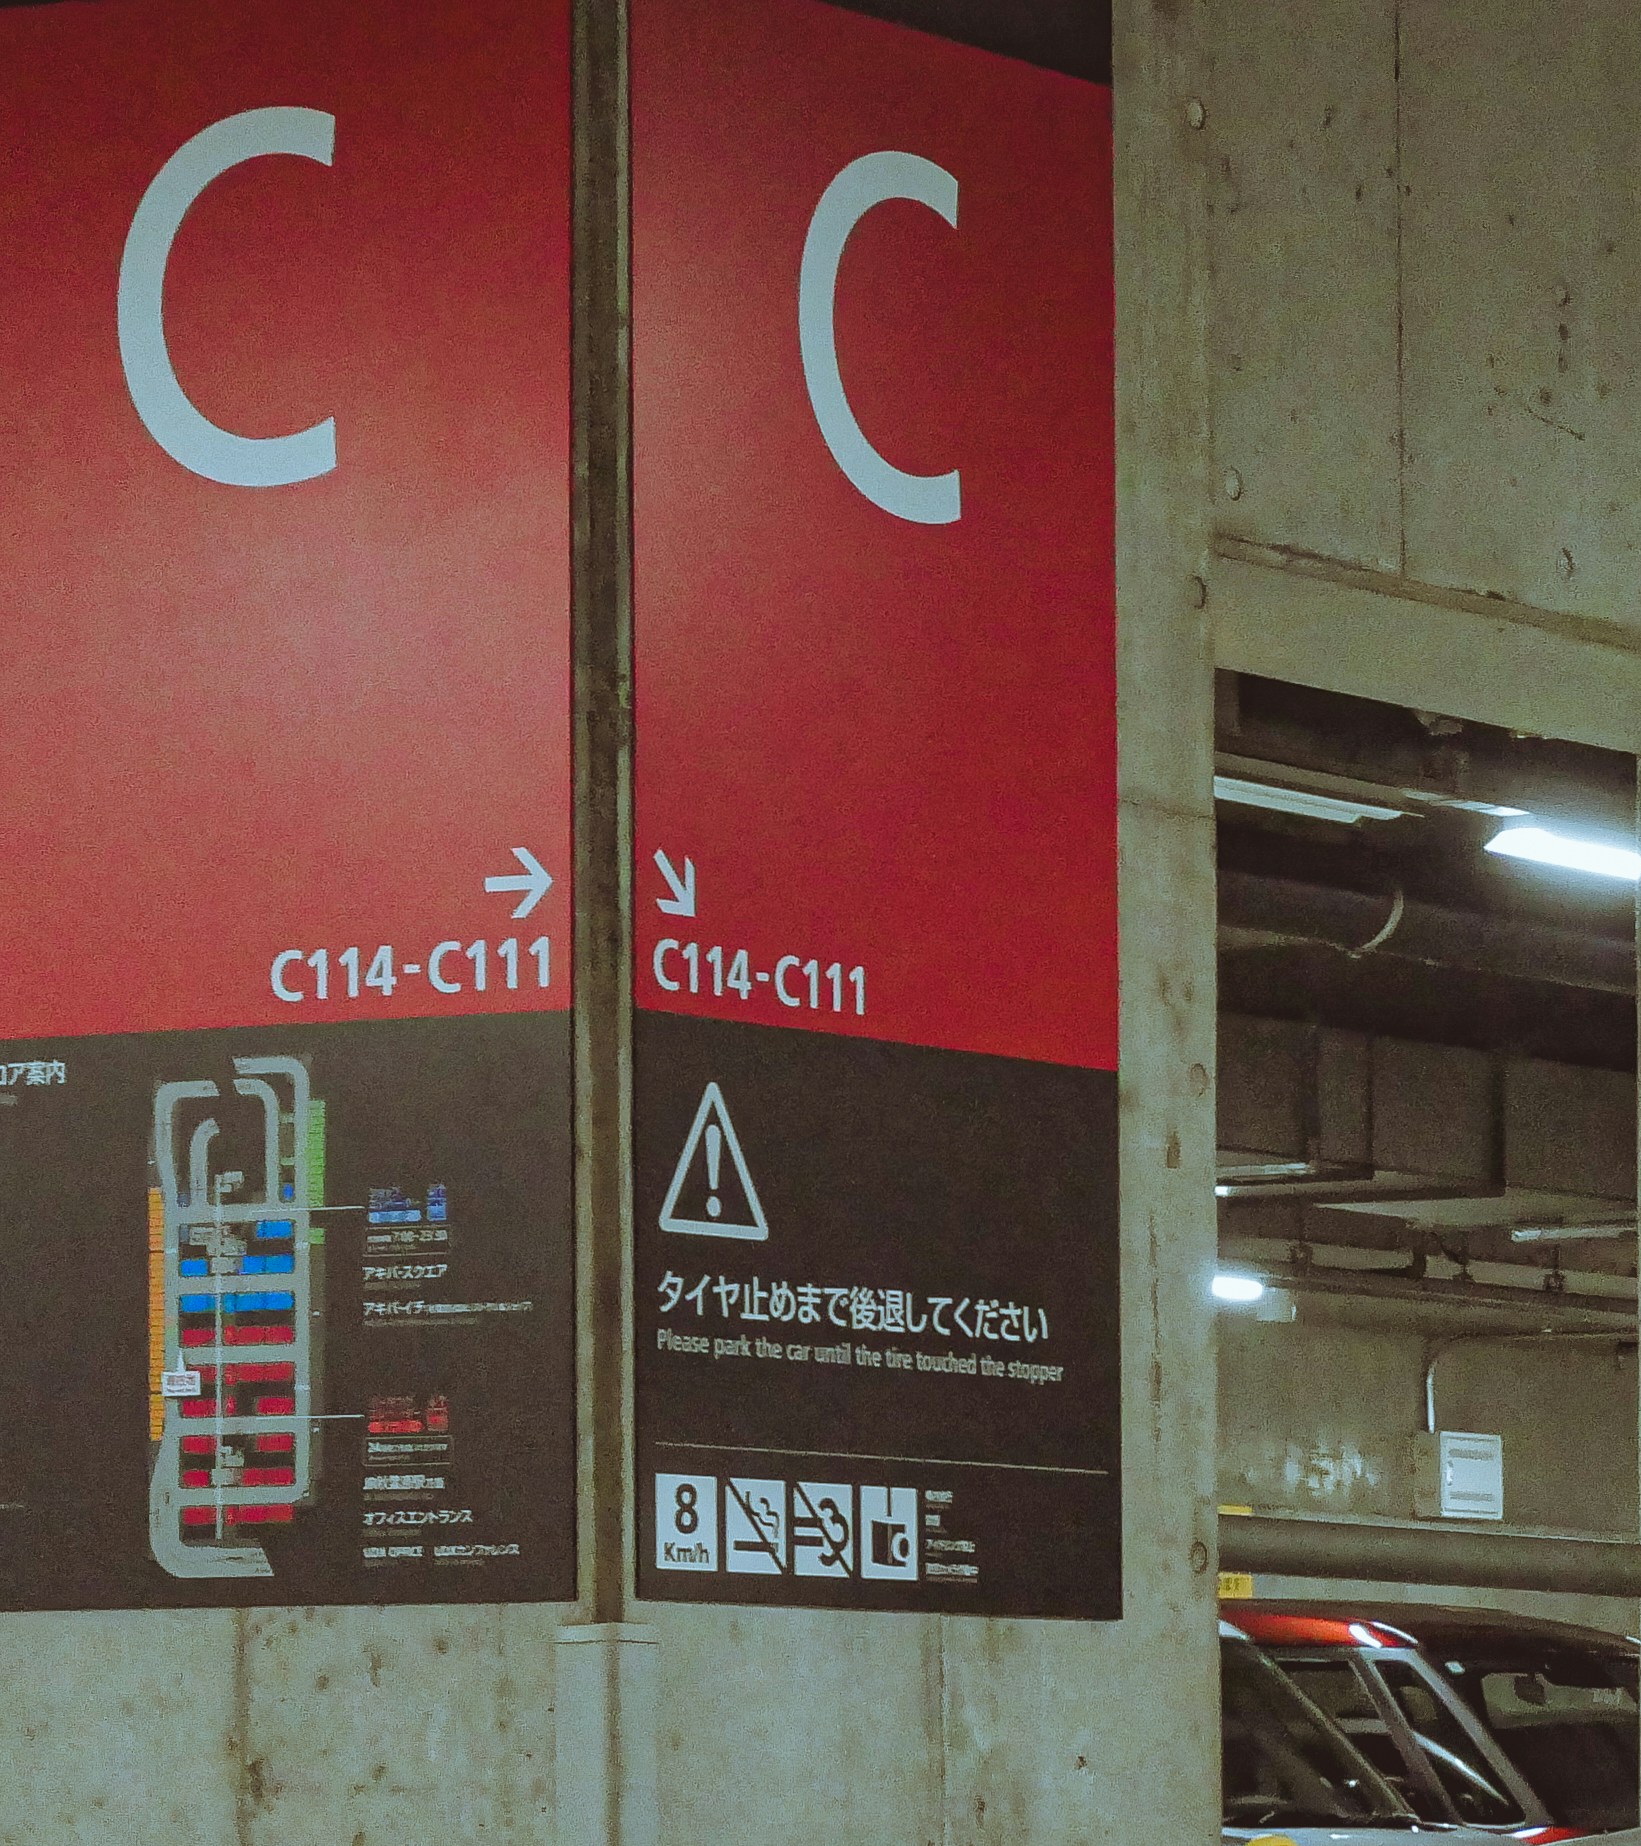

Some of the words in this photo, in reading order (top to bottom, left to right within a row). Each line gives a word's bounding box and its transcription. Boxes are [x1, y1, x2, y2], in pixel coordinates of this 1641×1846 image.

[117, 106, 337, 487] C
[799, 150, 961, 524] C
[270, 936, 550, 1002] C114-C111
[653, 938, 865, 1015] C114-C111
[657, 1270, 1049, 1343] タイヤ止めまで後退してください
[657, 1328, 710, 1354] Please
[713, 1334, 753, 1360] park
[755, 1337, 783, 1360] the
[786, 1342, 811, 1361] car
[814, 1342, 851, 1366] until
[855, 1344, 881, 1367] the
[885, 1346, 913, 1370] tire
[916, 1350, 977, 1375] touched
[980, 1354, 1005, 1378] the
[1008, 1360, 1065, 1386] stopper
[675, 1483, 698, 1534] 8
